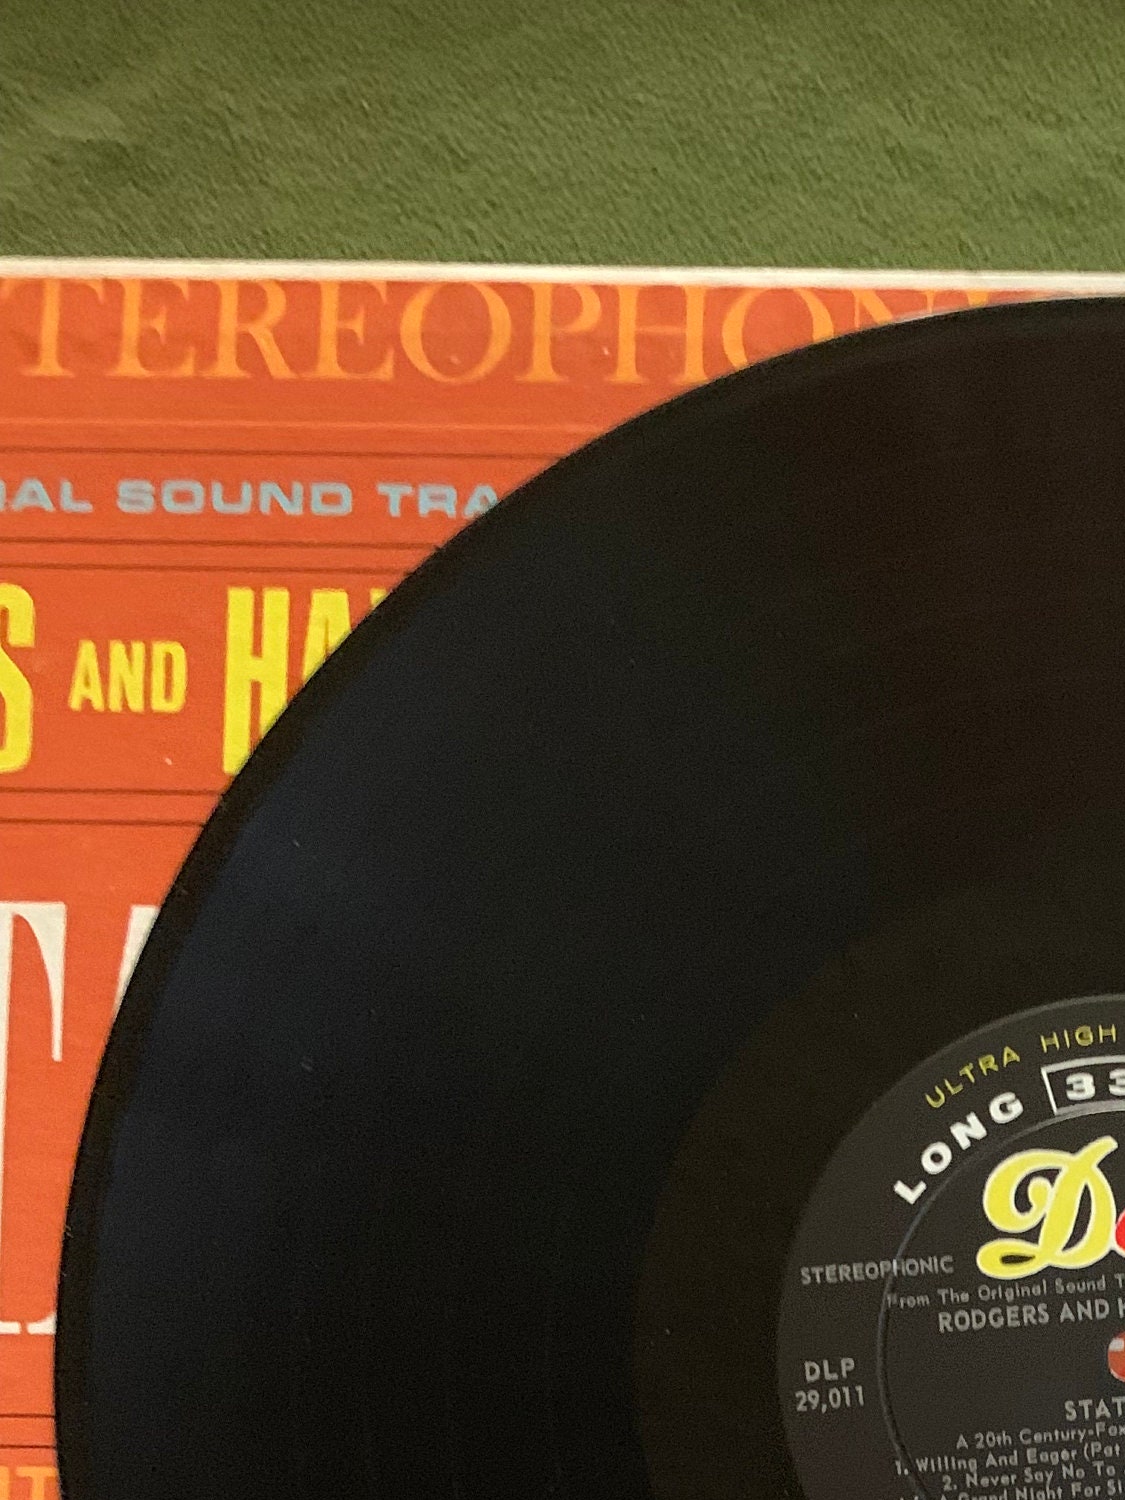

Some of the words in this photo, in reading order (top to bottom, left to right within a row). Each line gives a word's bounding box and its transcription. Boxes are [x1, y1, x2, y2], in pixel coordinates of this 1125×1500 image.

[116, 478, 353, 517] SOUND
[69, 640, 188, 713] AND
[925, 1046, 1020, 1109] ULTRA
[1040, 1024, 1116, 1053] HIGH
[894, 1091, 1024, 1205] LONG
[801, 1256, 954, 1285] STEREOPHONIC
[938, 1288, 969, 1305] The
[978, 1281, 1047, 1303] Original
[1055, 1275, 1105, 1295] Sound
[939, 1303, 1049, 1333] RODGERS
[1059, 1299, 1110, 1323] AND
[805, 1358, 855, 1382] DLP
[796, 1385, 864, 1414] 29,011
[956, 1435, 968, 1449] A
[974, 1431, 1012, 1449] 20th
[916, 1456, 977, 1473] Willing
[986, 1450, 1018, 1468] And
[1027, 1446, 1078, 1465] Eager
[1083, 1441, 1120, 1457] (Pat
[965, 1472, 1016, 1488] Never
[1024, 1467, 1053, 1487] Say
[1061, 1463, 1085, 1480] No
[1093, 1461, 1115, 1476] To
[1072, 1481, 1101, 1497] For
